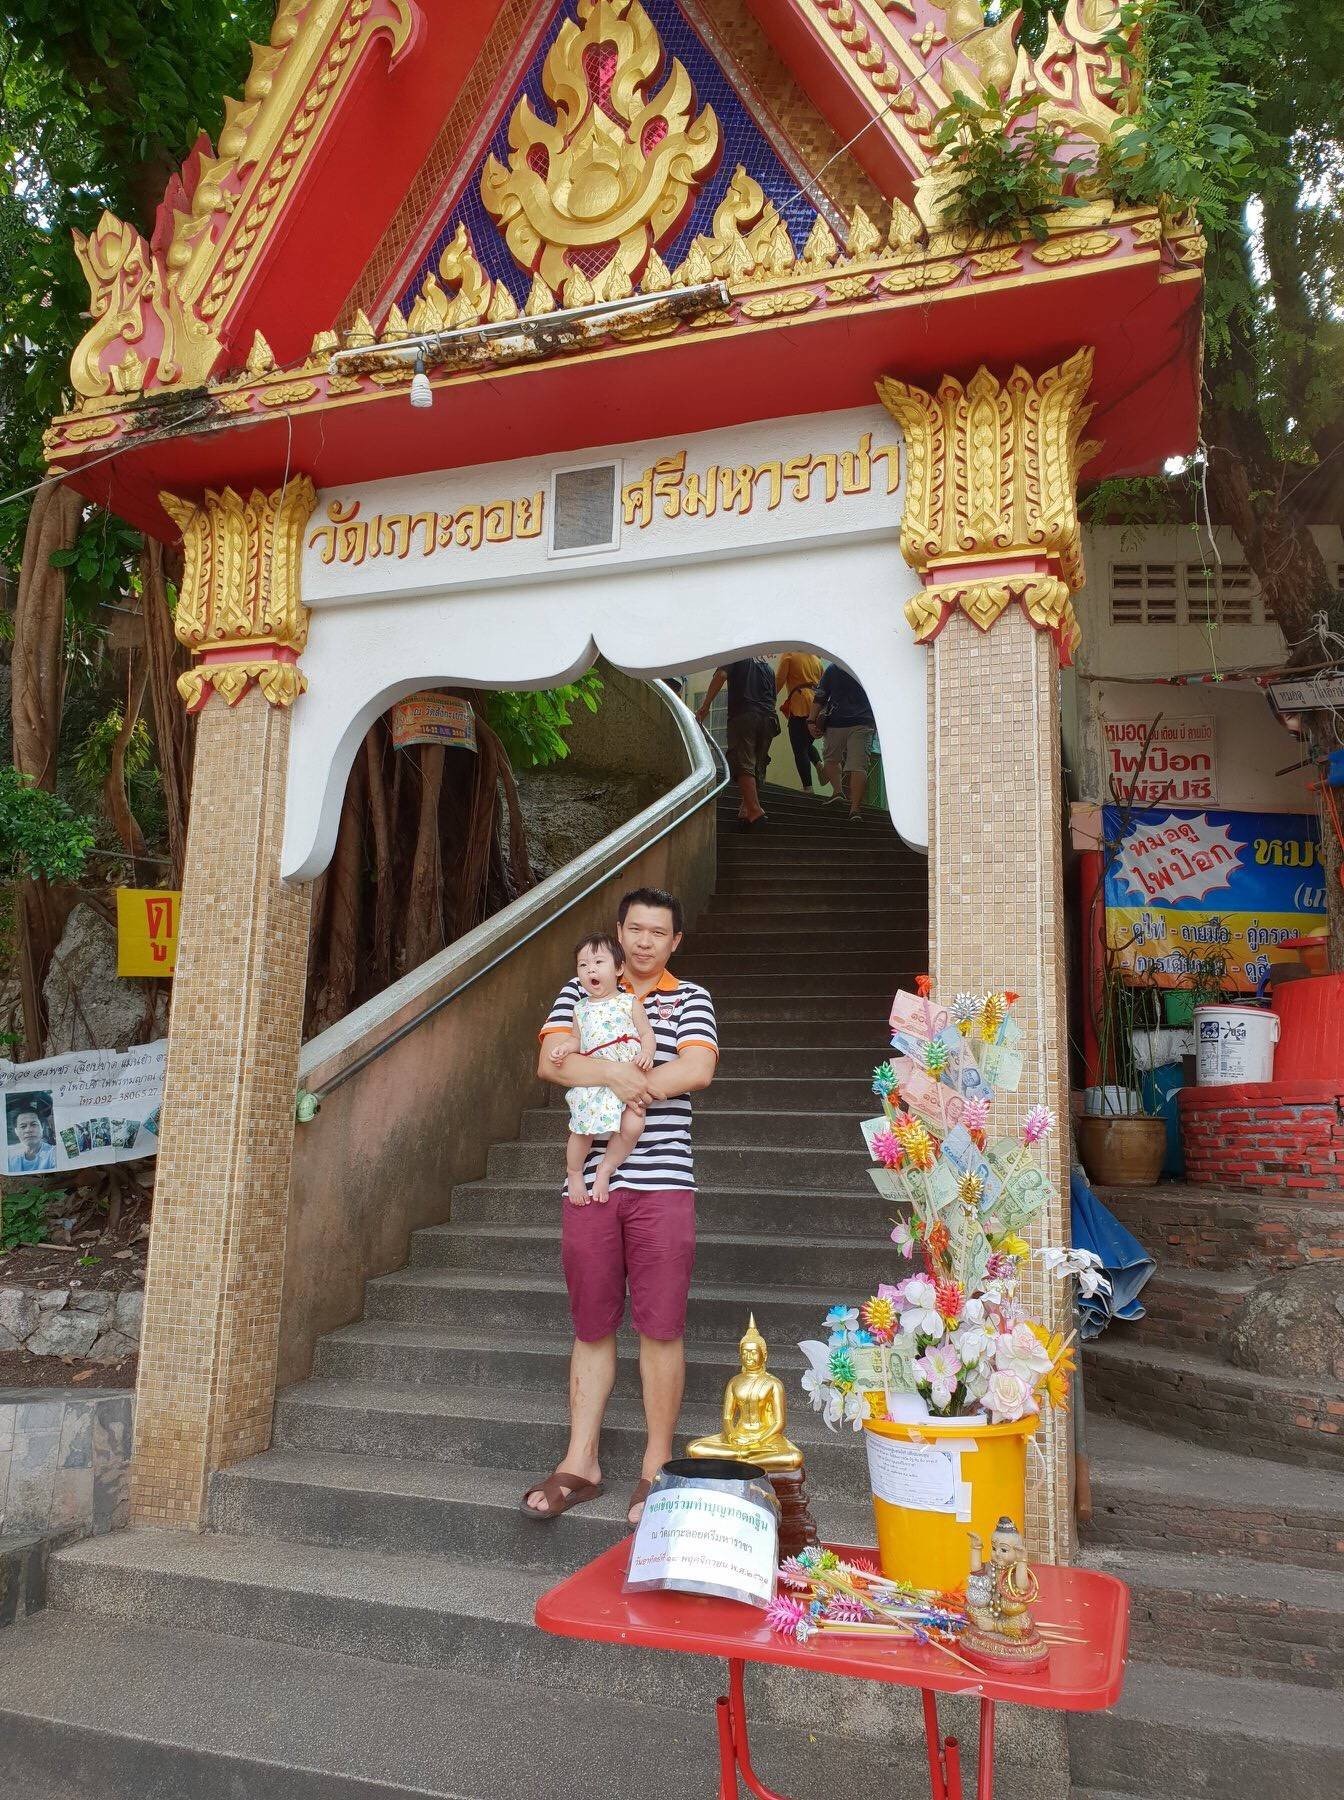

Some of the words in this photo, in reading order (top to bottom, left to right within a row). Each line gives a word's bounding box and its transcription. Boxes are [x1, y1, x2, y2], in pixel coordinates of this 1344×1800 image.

[309, 491, 545, 566] วัดเกาะลอย
[621, 432, 902, 529] ศรีมหาราชา
[1105, 723, 1147, 747] หมอดู
[1129, 822, 1201, 858] หมอดู
[1130, 844, 1234, 895] ไพ่ป๊อก
